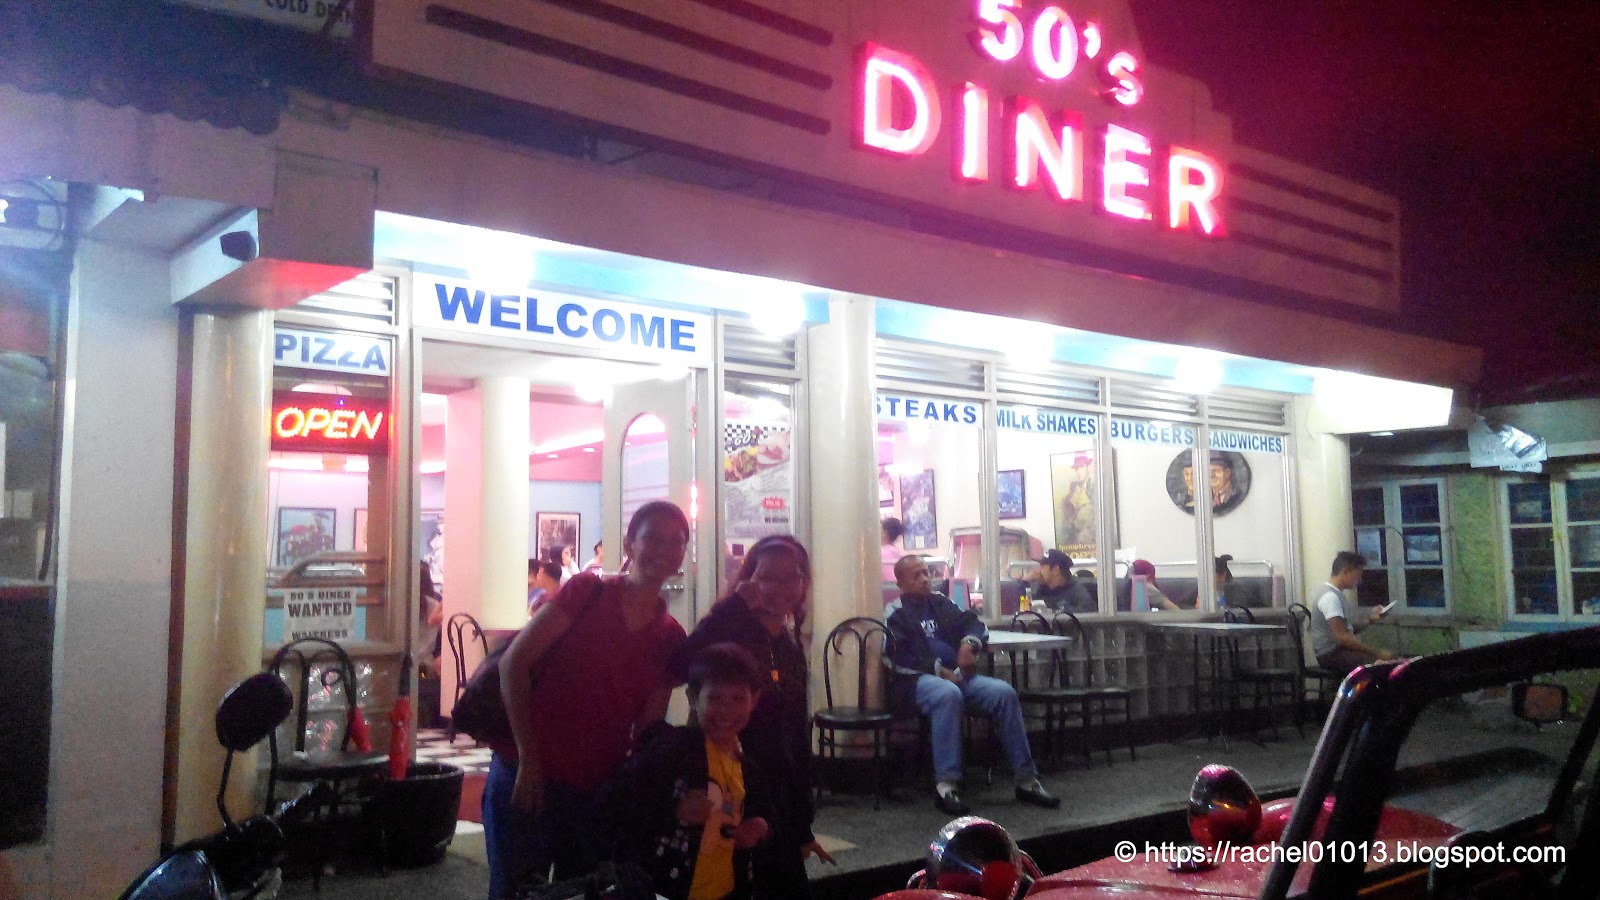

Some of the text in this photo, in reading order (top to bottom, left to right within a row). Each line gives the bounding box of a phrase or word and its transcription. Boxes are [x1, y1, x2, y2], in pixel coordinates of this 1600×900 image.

[862, 41, 1226, 237] DINER
[435, 283, 696, 352] WELCOME
[275, 333, 387, 371] PIZZA
[275, 406, 384, 440] OPEN
[997, 409, 1096, 435] MILK SHAKES
[1111, 420, 1194, 446] BURGERS
[287, 602, 352, 618] WANTED
